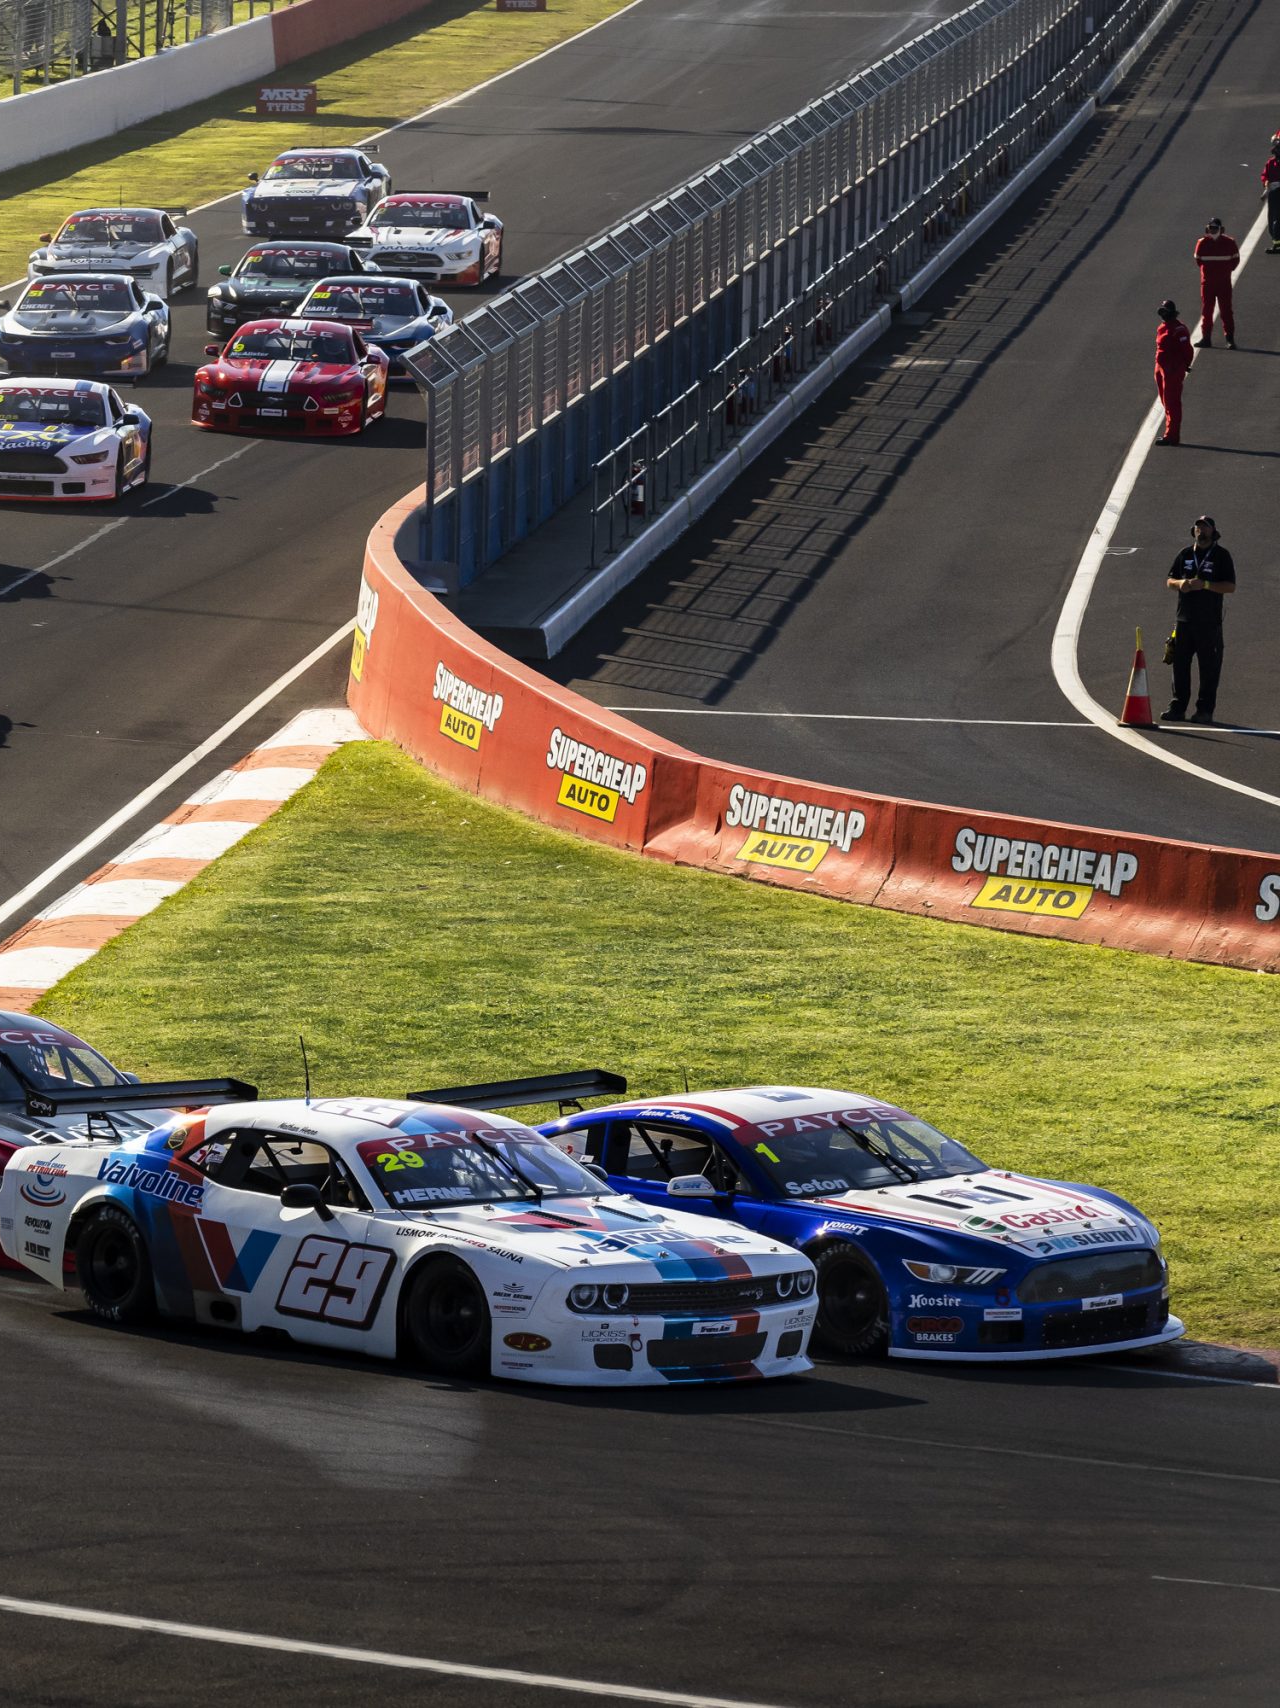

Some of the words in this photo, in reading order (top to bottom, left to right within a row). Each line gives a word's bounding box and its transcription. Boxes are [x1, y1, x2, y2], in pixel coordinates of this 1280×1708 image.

[259, 88, 312, 101] MRF
[266, 102, 305, 112] TYRES
[327, 285, 401, 295] PAYCE
[253, 329, 333, 338] PAYCE
[233, 343, 245, 352] 9
[0, 387, 88, 399] PAYCE
[432, 660, 503, 733] SUPERCHEAP
[445, 713, 476, 741] AUTO
[546, 727, 647, 805] SUPERCHEAP
[566, 783, 610, 813] AUTO
[726, 783, 866, 853] SUPERCHEAP
[749, 838, 816, 864] AUTO
[951, 827, 1139, 897] SUPERCHEAP
[988, 884, 1078, 911] AUTO
[761, 1107, 899, 1137] PAYCE
[386, 1128, 536, 1152] PAYCE
[376, 1150, 426, 1172] 29
[754, 1143, 780, 1163] 1
[26, 1164, 68, 1178] PETROLEUM
[96, 1158, 205, 1206] Valvoline
[392, 1186, 473, 1204] HERNE
[785, 1177, 850, 1196] Seton
[1000, 1205, 1113, 1229] Castrol
[822, 1221, 869, 1236] VOIGHT
[395, 1226, 436, 1239] LISMORE
[486, 1245, 525, 1265] SAUNA
[276, 1234, 398, 1331] 29
[907, 1294, 962, 1309] Hoosier
[581, 1330, 627, 1338] LICKISS
[916, 1333, 954, 1342] BRAKES
